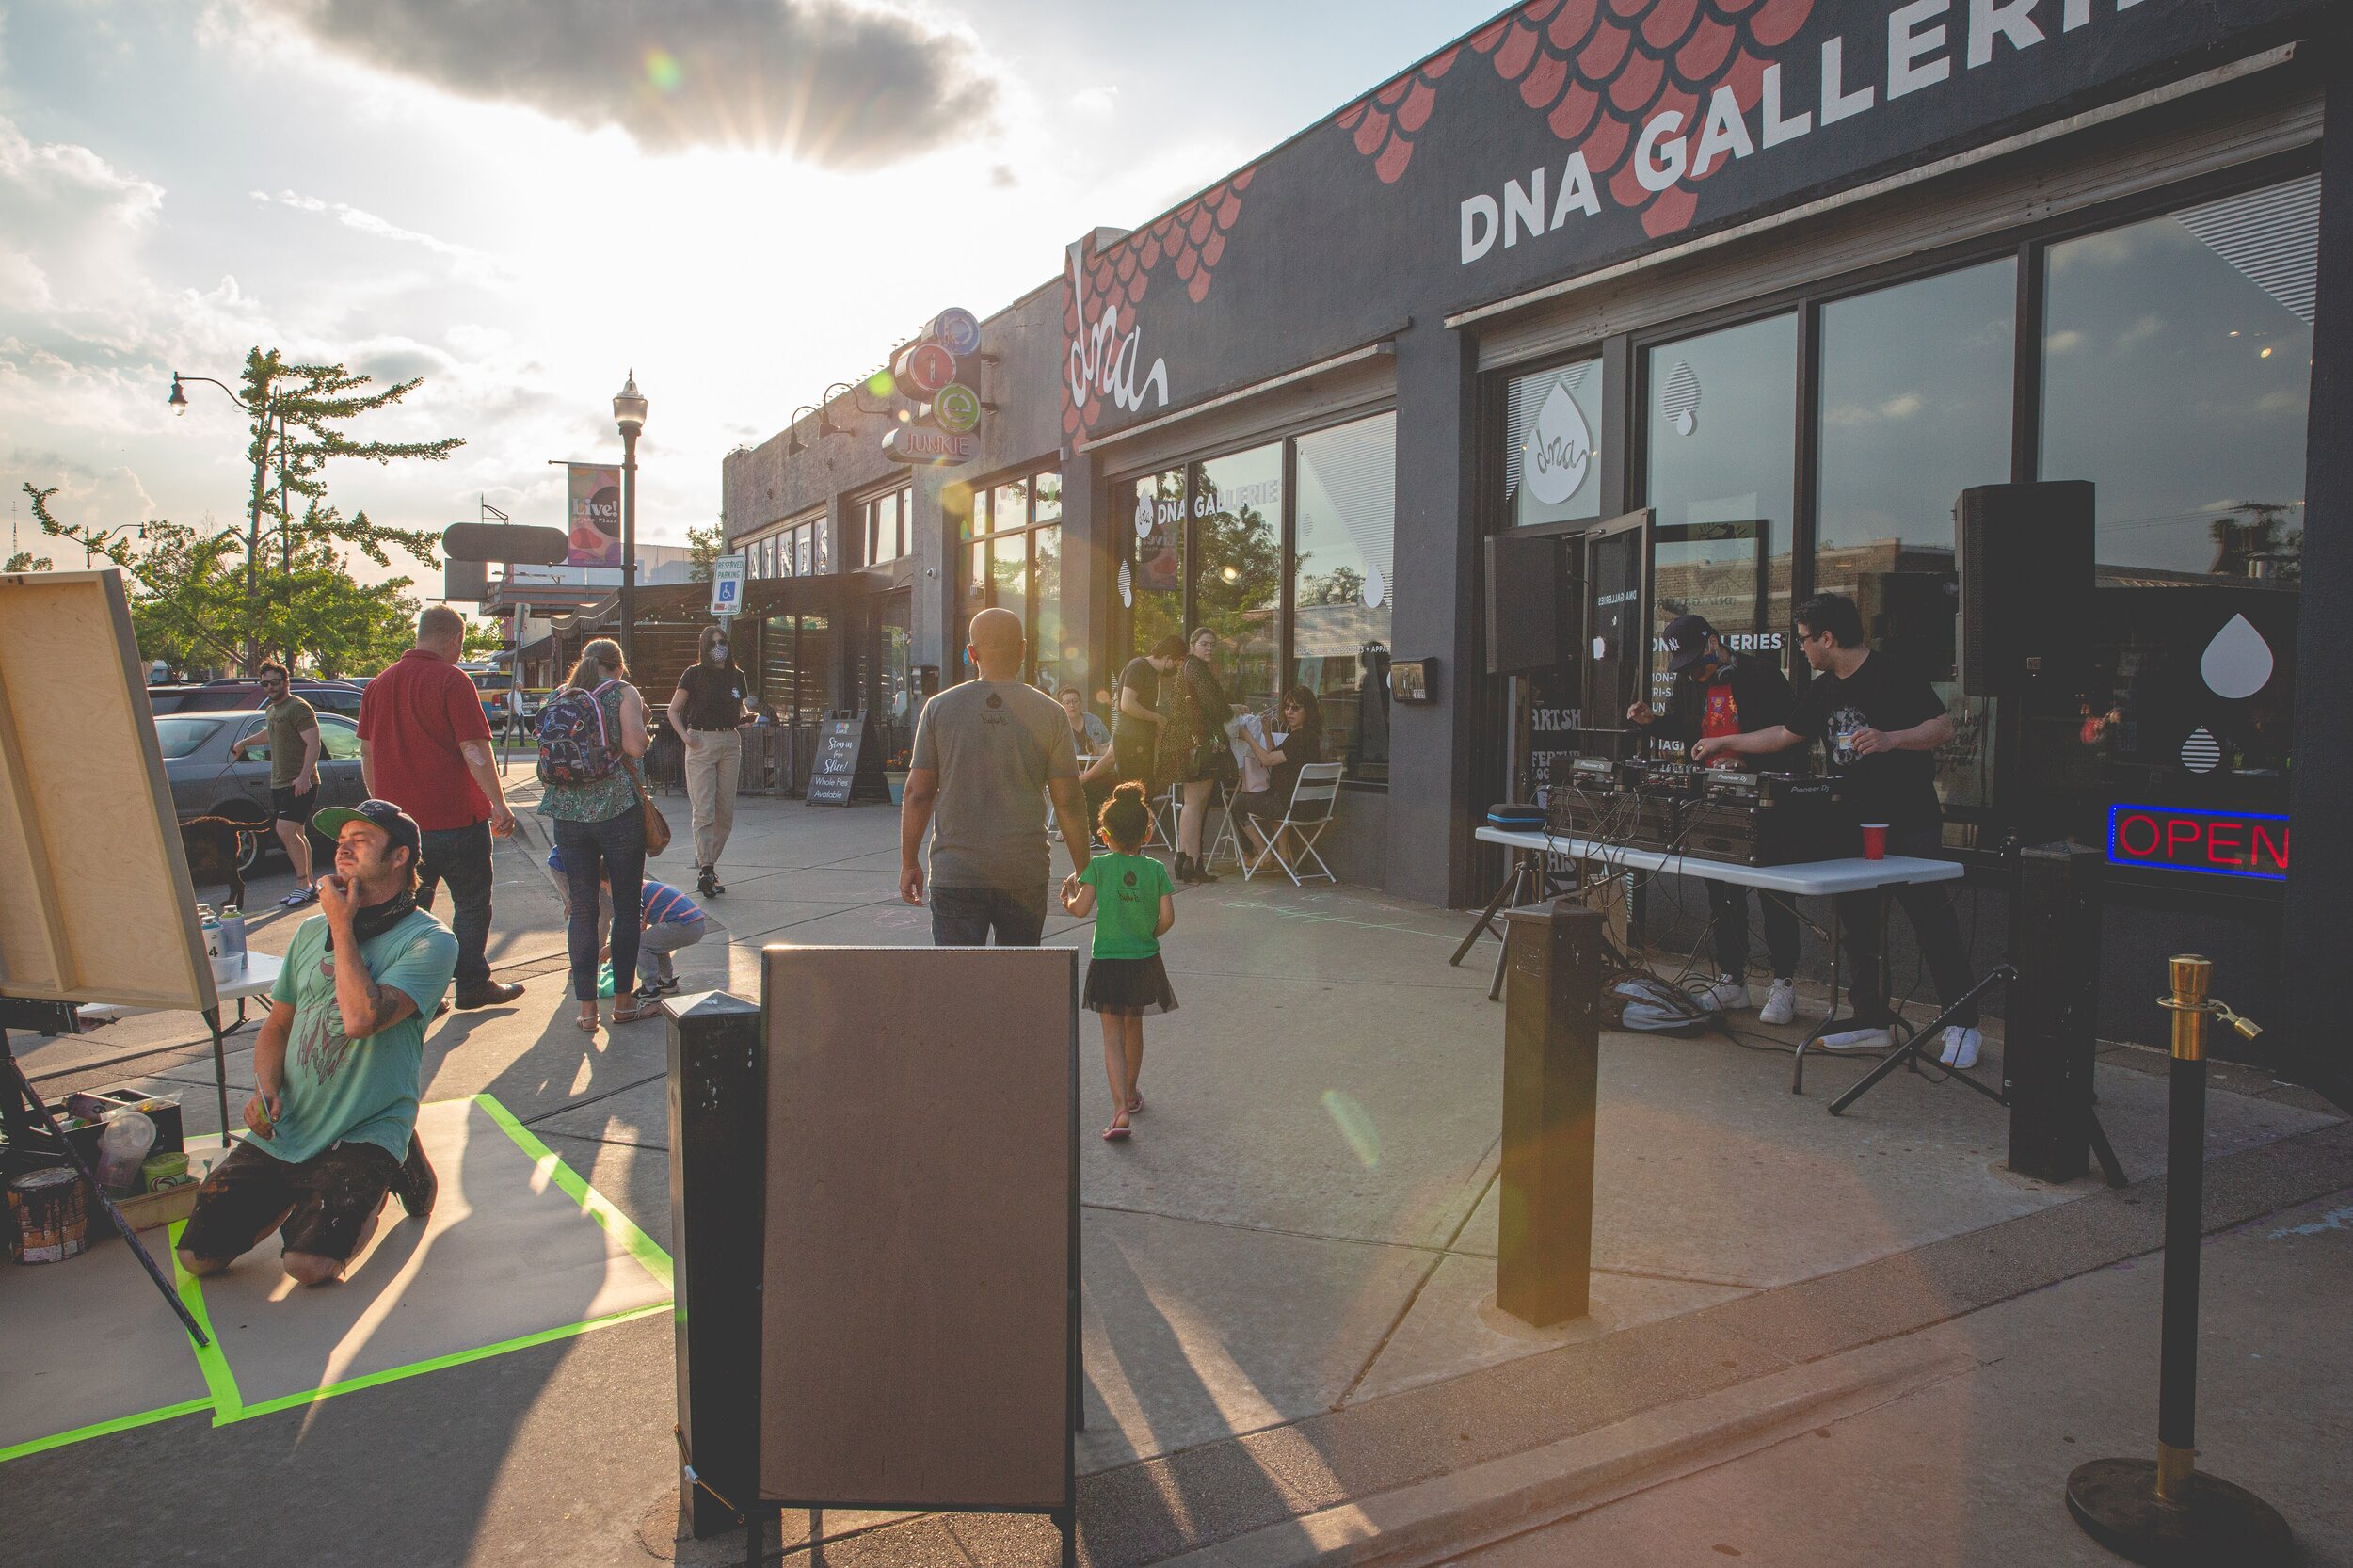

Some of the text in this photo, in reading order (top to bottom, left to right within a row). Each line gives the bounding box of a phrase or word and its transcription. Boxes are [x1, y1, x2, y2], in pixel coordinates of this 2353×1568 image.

[1461, 0, 2145, 264] DNA GALLER
[906, 433, 971, 456] JUNKIE
[572, 498, 618, 517] Live!
[1157, 478, 1281, 525] DNA GALLERIE
[824, 758, 849, 774] Slice!
[815, 777, 849, 787] Whole Pies
[813, 790, 842, 799] Available
[2120, 815, 2289, 869] OPEN
